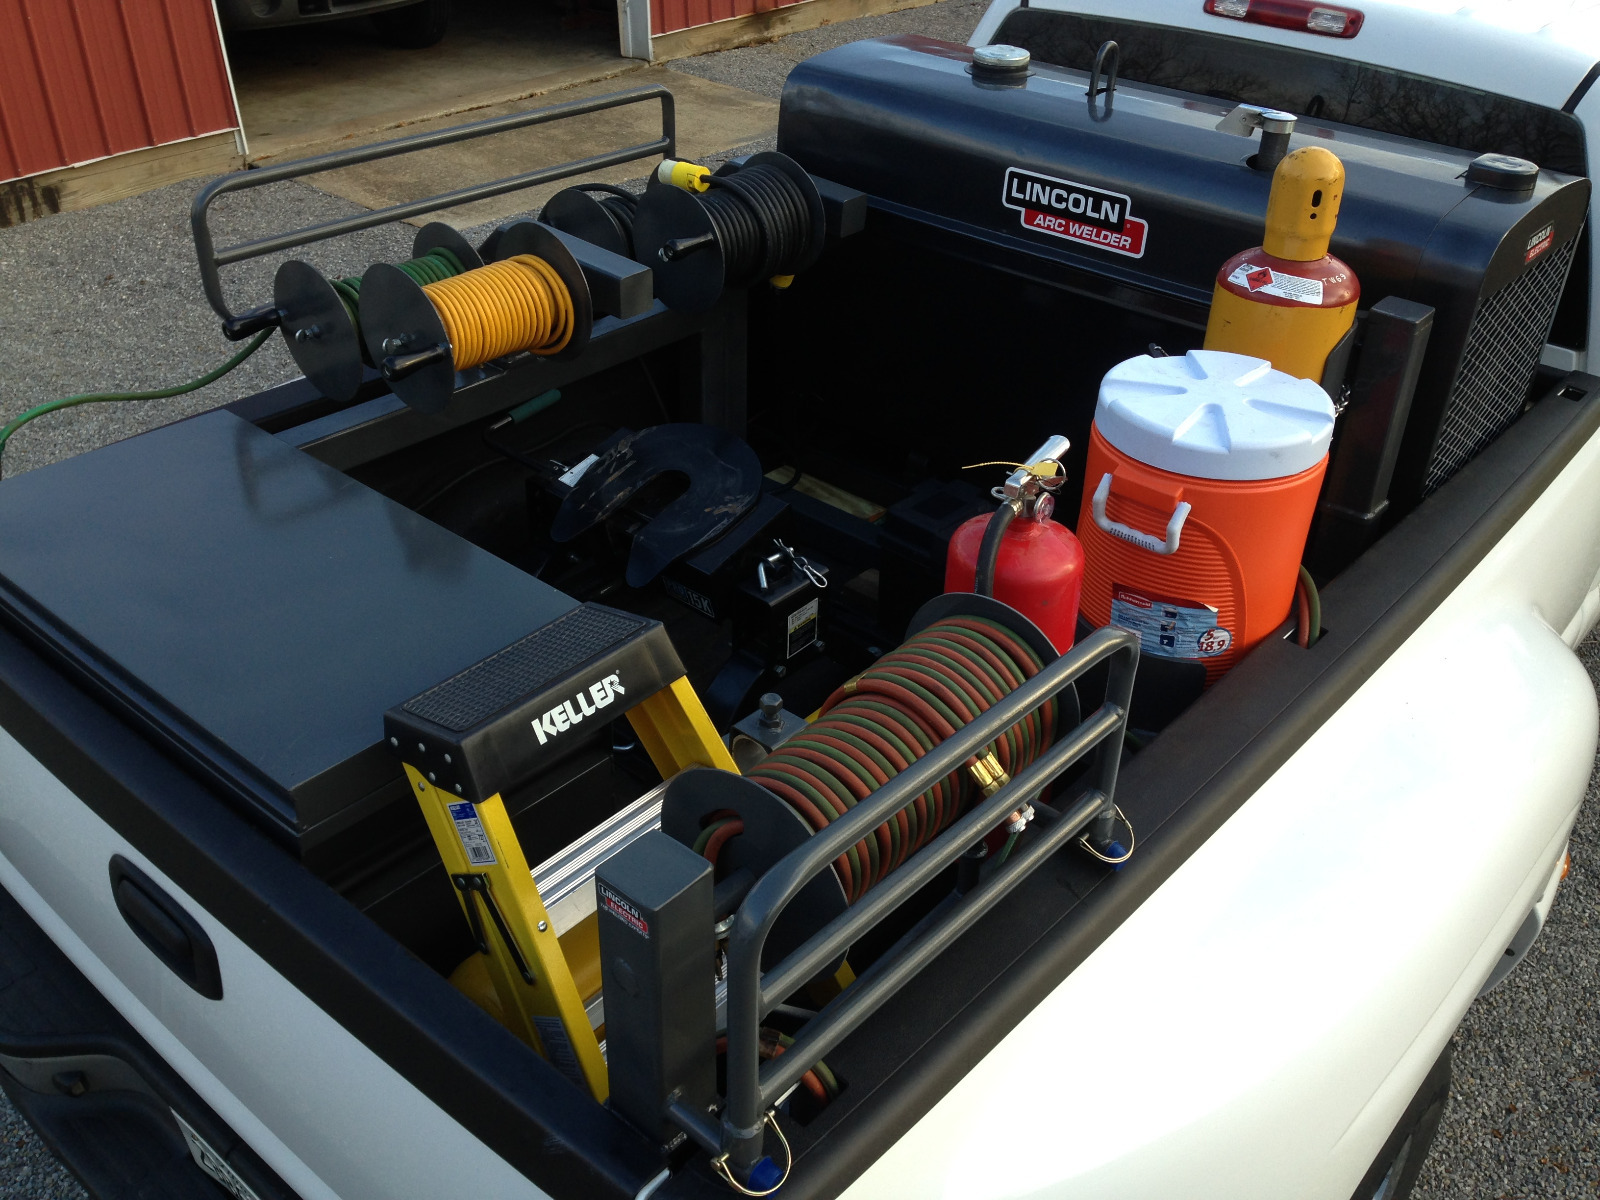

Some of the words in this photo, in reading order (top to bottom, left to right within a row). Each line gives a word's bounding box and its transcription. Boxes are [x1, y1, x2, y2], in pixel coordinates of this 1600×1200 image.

[1011, 177, 1120, 224] LINCOLN
[1033, 214, 1066, 232] ARC
[1069, 223, 1132, 249] WELDER
[1198, 640, 1225, 652] 18.9
[1204, 629, 1215, 641] 5
[531, 674, 625, 746] KELLER
[601, 886, 639, 918] LINCOLN
[610, 901, 644, 929] ELECTRIC
